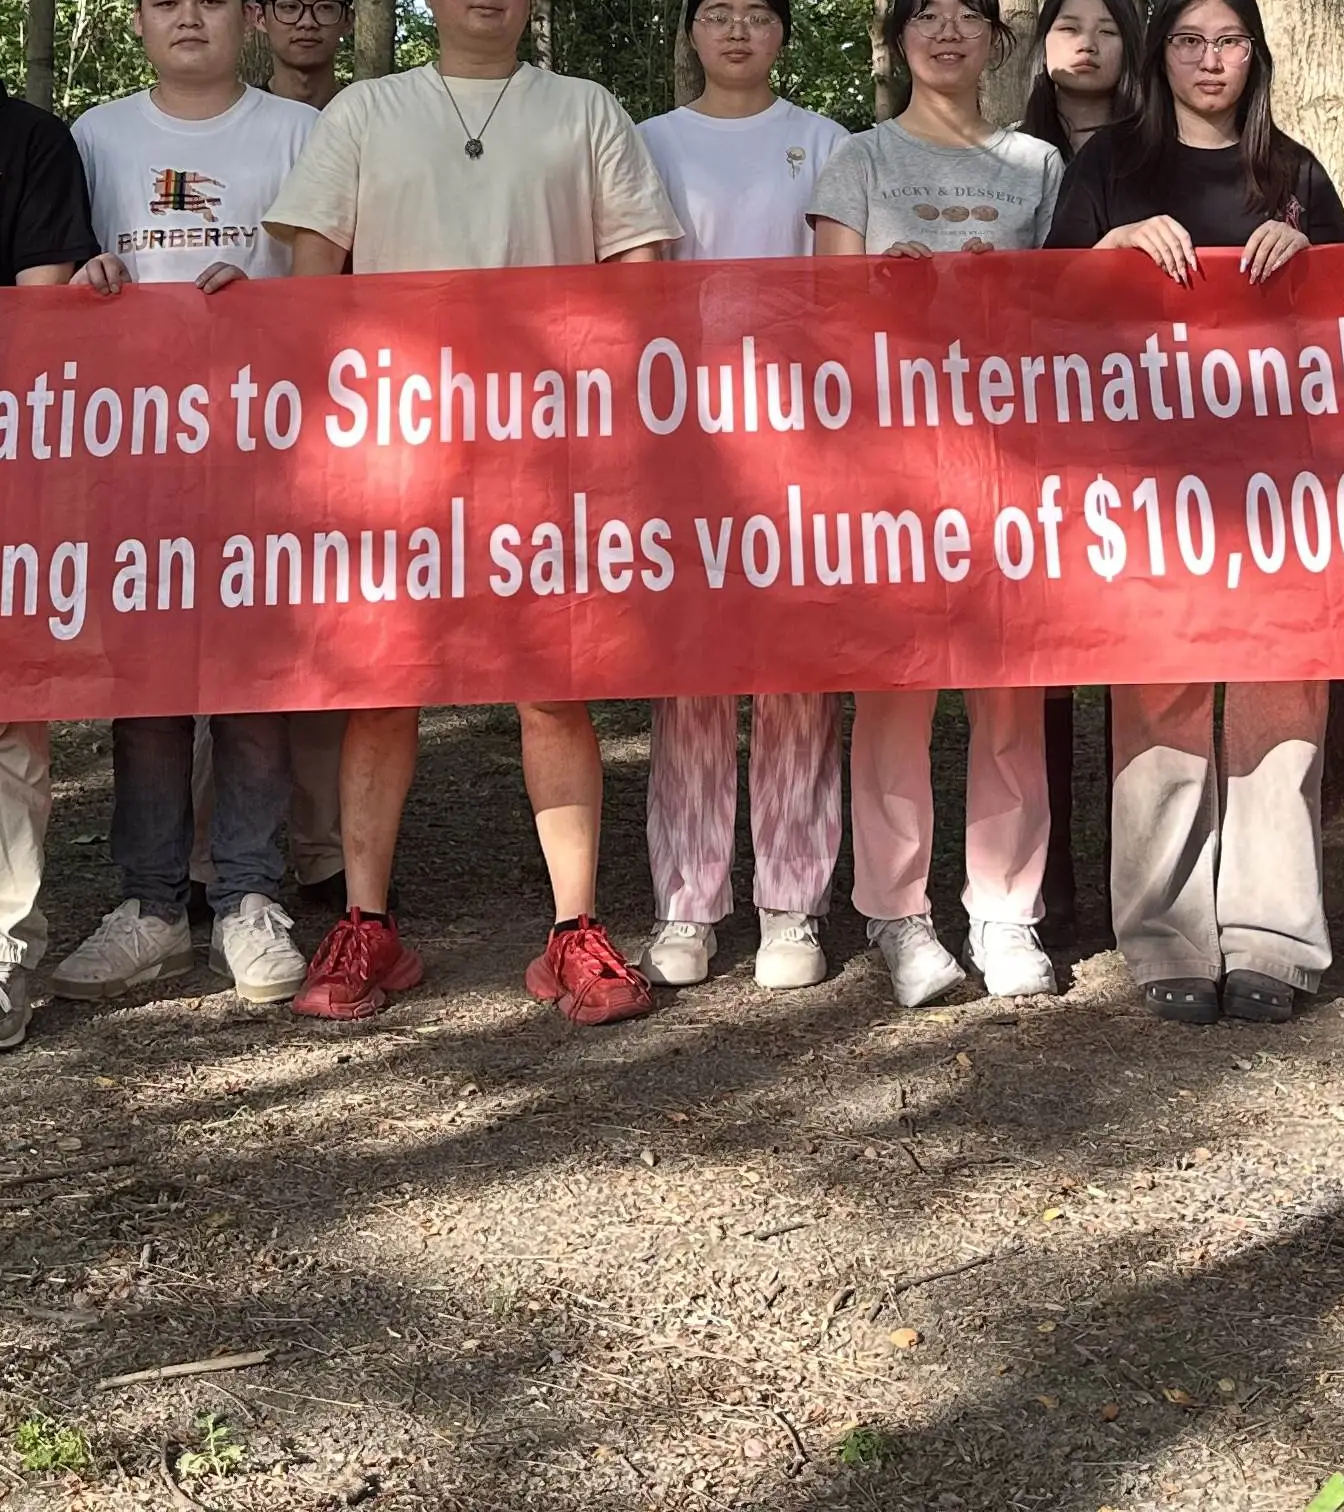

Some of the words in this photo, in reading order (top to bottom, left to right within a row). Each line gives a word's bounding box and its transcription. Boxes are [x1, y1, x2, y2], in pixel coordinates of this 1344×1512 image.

[882, 186, 930, 200] LUCKY
[937, 187, 949, 197] &
[955, 187, 1025, 206] DESSERT
[118, 226, 258, 254] BURBERRY
[231, 364, 302, 451] to
[325, 347, 612, 449] Sichuan
[638, 335, 851, 435] Ouluo
[112, 537, 195, 613] an
[220, 498, 464, 609] annual
[487, 493, 674, 597] sales
[695, 484, 970, 589] volume
[994, 475, 1064, 581] of
